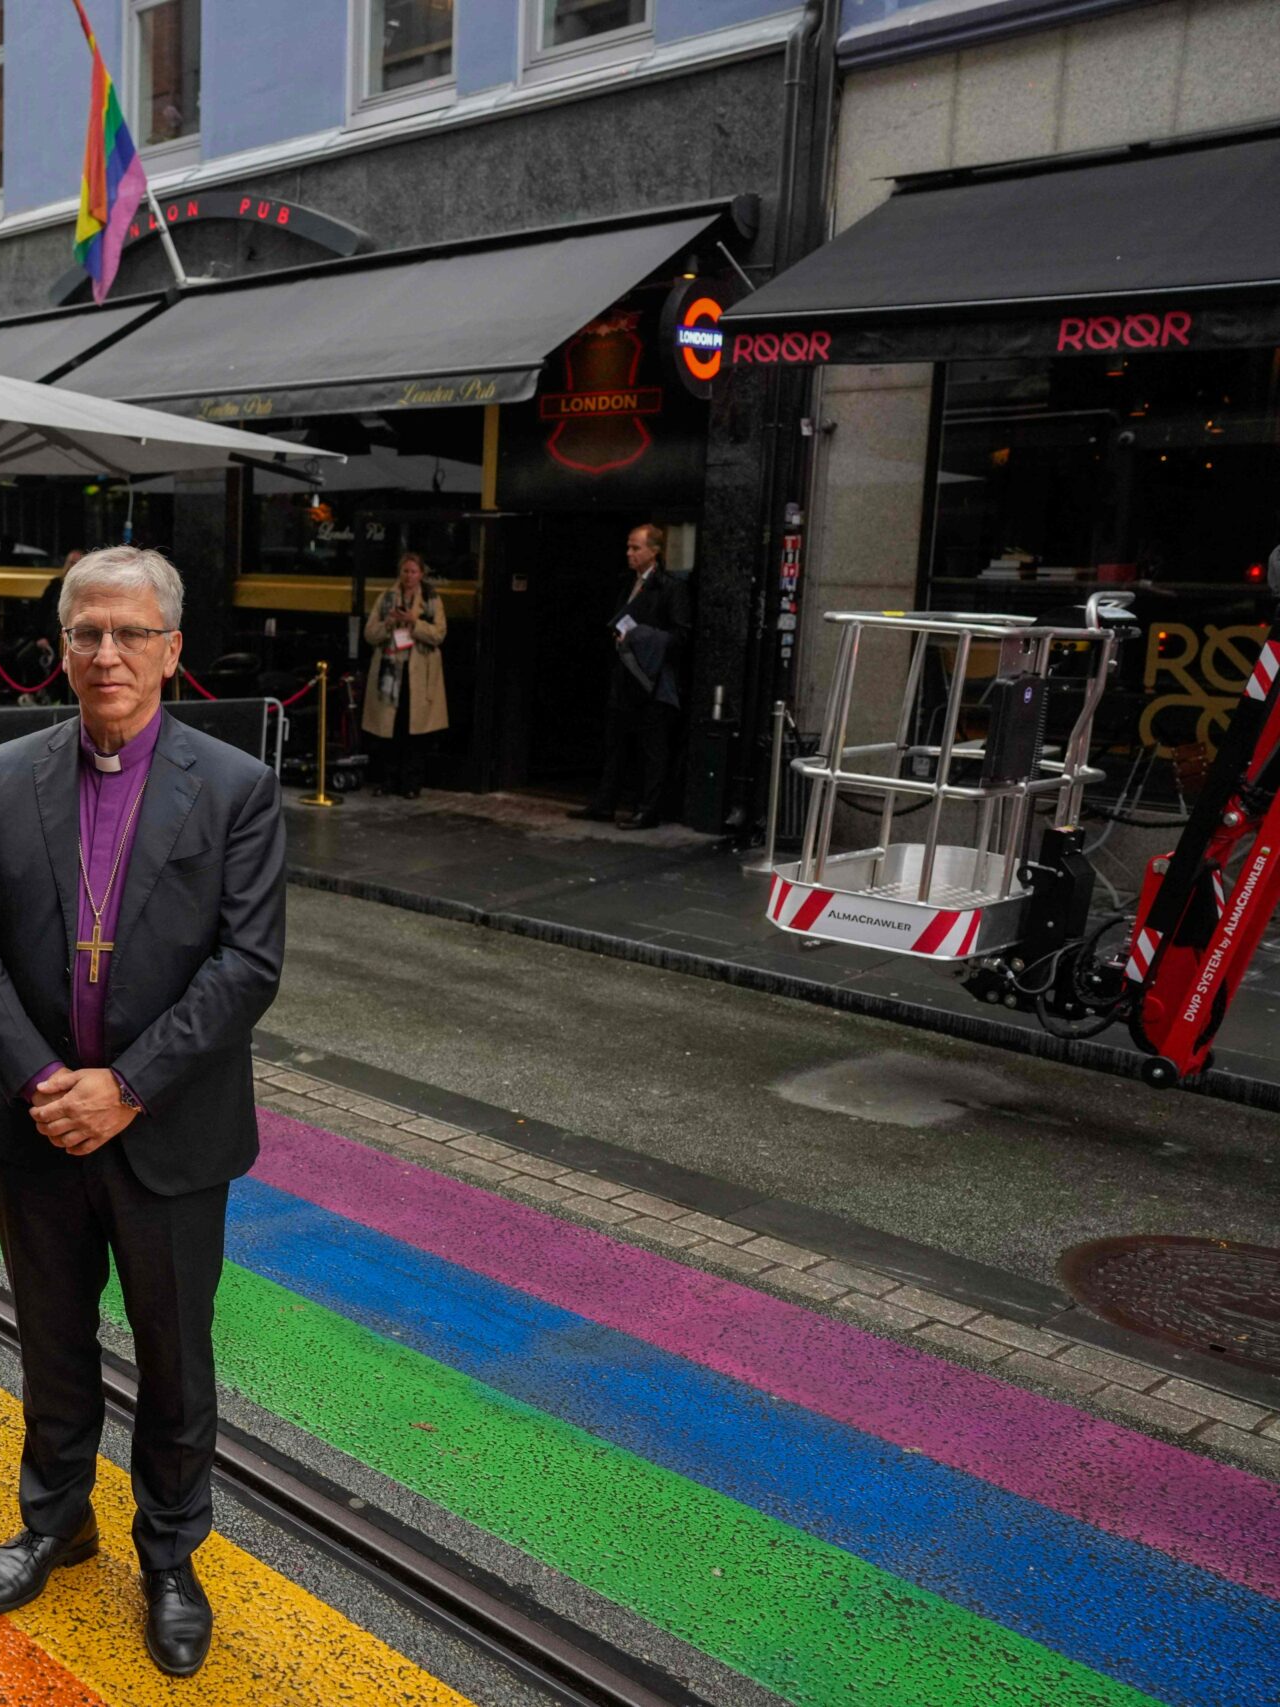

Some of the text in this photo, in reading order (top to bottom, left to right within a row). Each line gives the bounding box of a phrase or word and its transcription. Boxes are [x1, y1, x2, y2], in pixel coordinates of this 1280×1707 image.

[239, 197, 290, 225] PUB
[679, 329, 713, 345] LONDON
[398, 377, 496, 406] London Pub
[561, 395, 638, 412] LONDON
[242, 394, 273, 416] Pub
[1184, 994, 1202, 1022] DWP
[1196, 949, 1224, 994] SYSTEM
[1219, 937, 1232, 949] by
